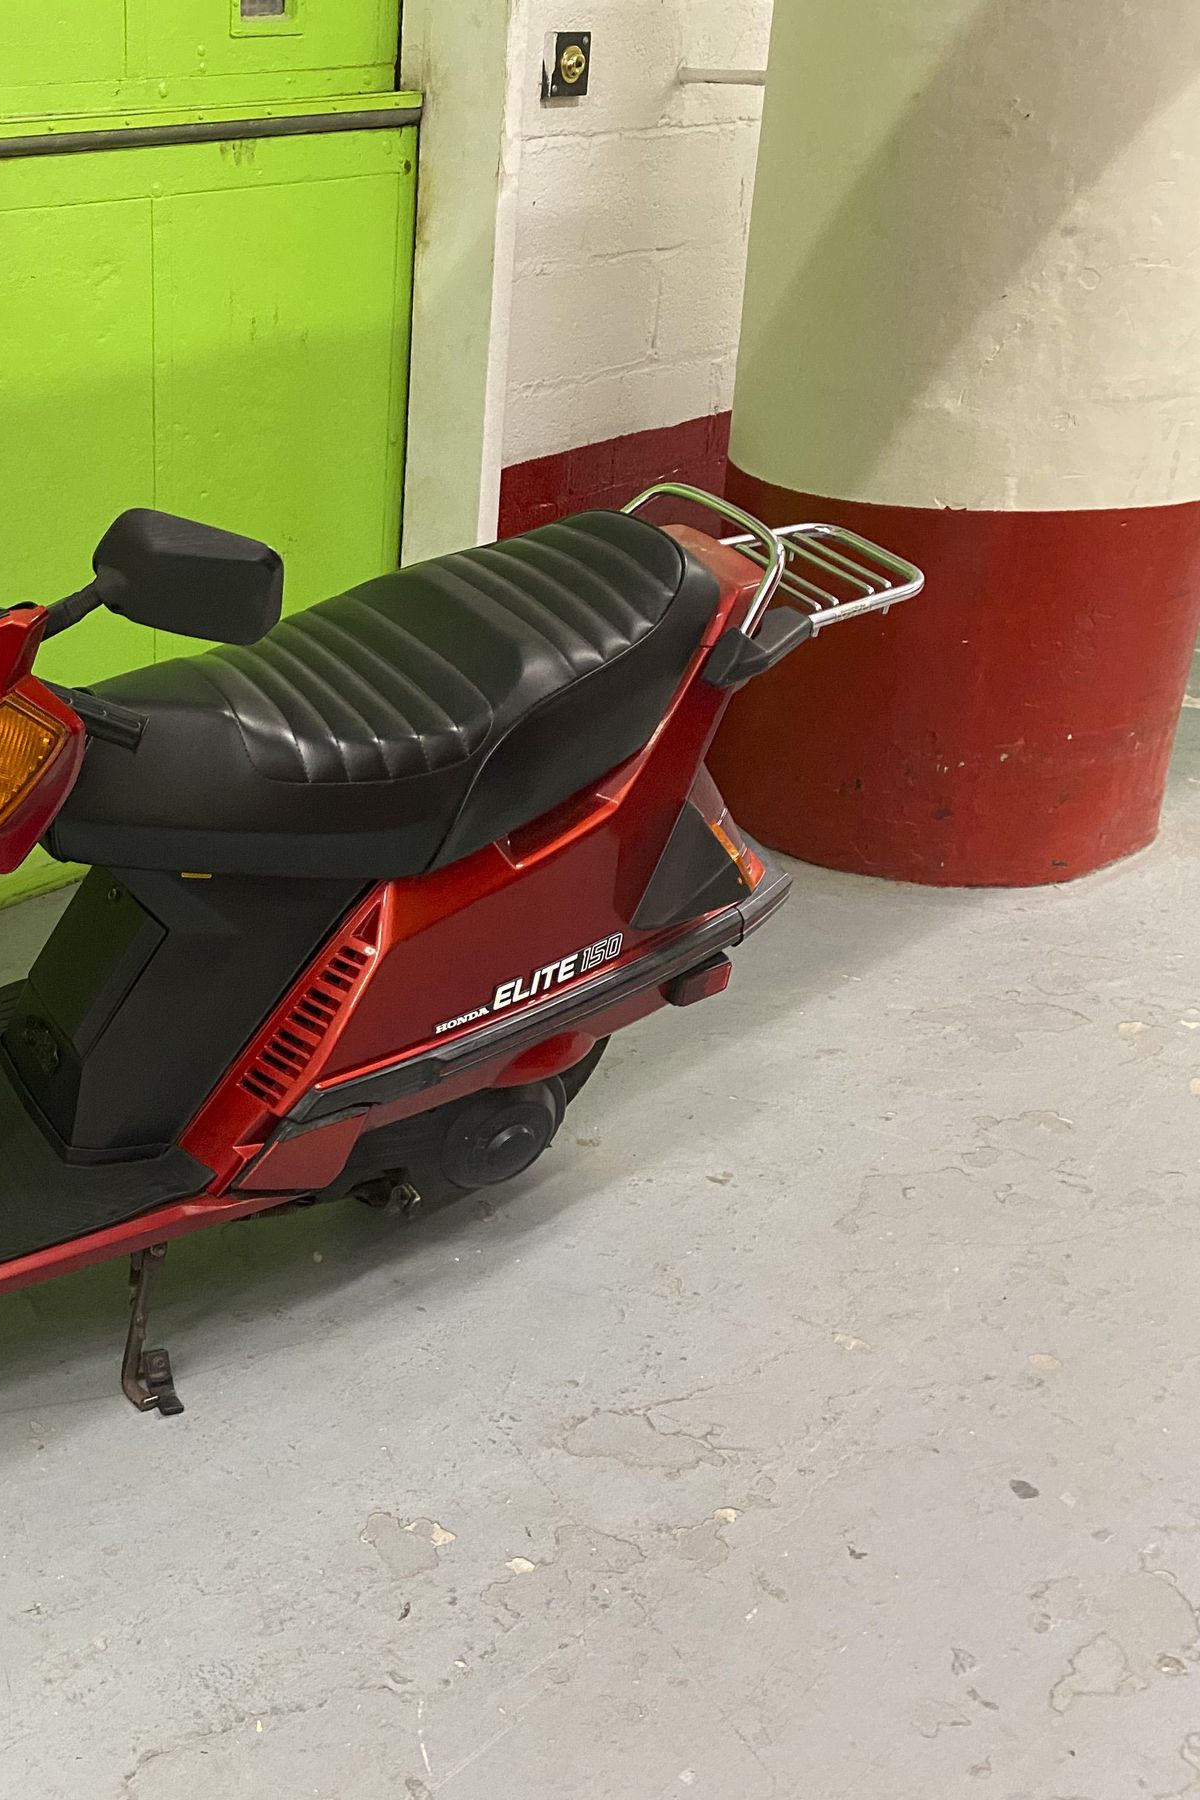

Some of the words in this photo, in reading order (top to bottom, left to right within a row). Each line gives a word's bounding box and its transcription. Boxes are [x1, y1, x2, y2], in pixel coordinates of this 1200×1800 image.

[435, 1007, 490, 1034] HONDA
[492, 953, 578, 1010] ELITE
[580, 932, 624, 973] 150
